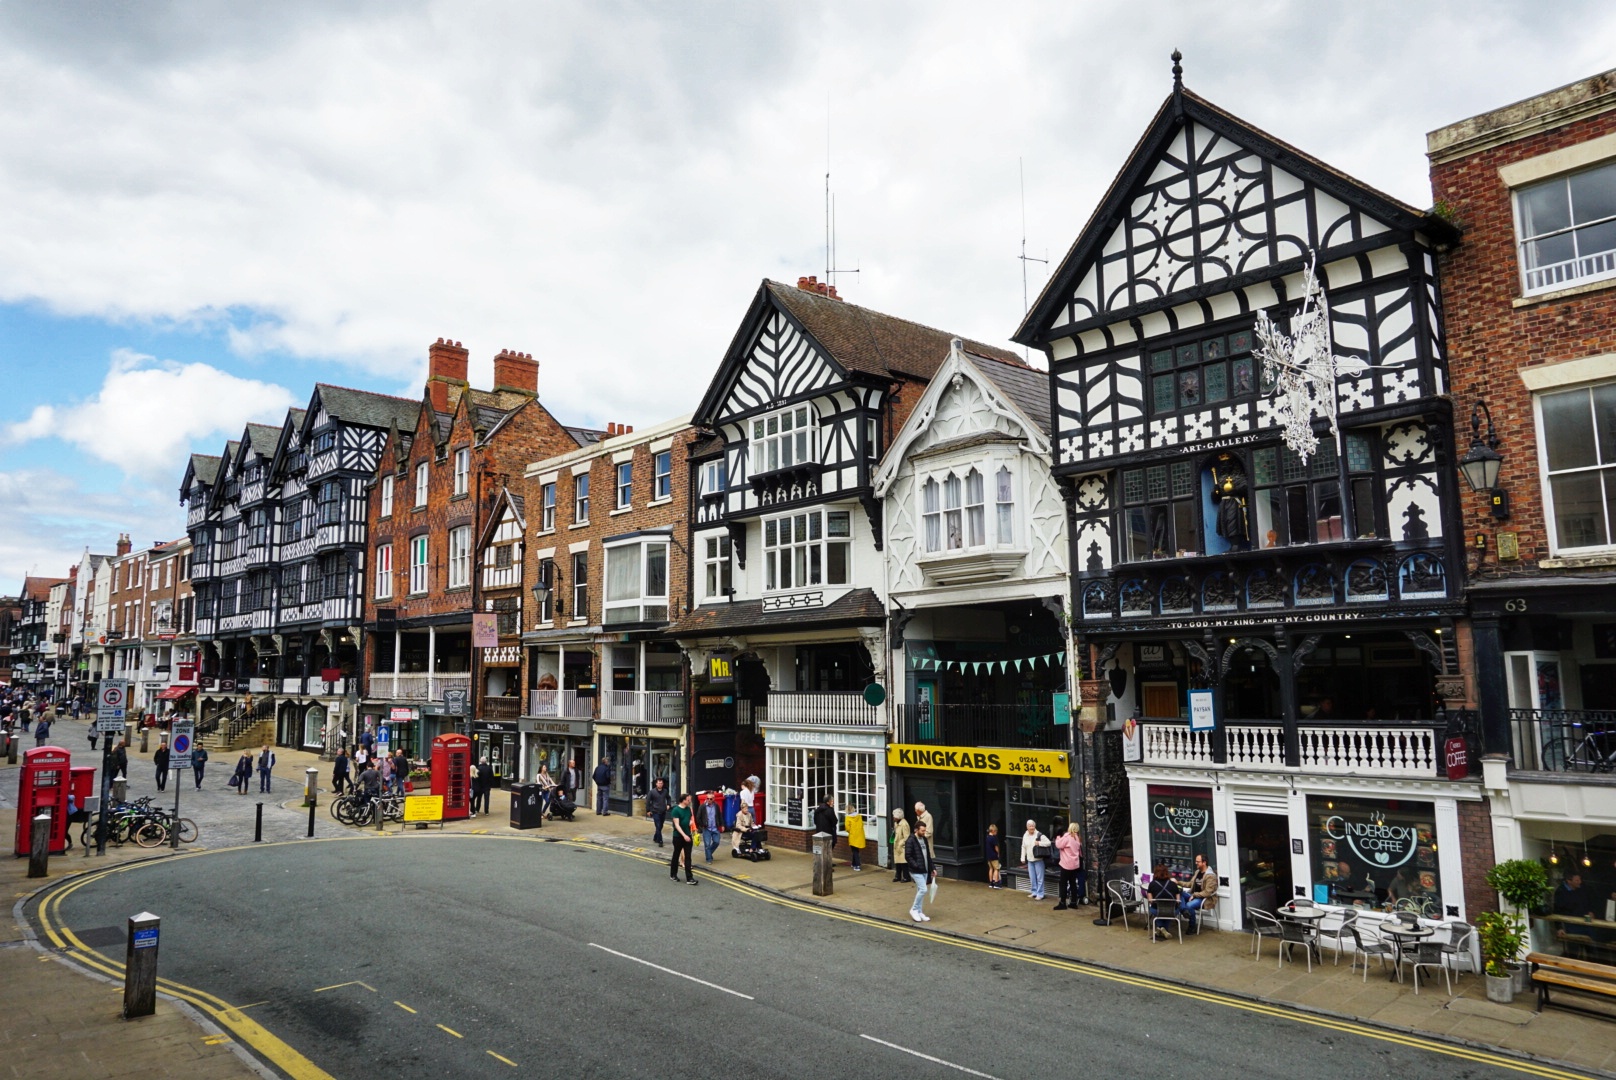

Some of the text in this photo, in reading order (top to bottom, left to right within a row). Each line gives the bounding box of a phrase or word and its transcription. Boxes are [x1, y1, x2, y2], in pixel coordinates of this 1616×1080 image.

[1182, 434, 1257, 454] ART GALLERY
[1505, 598, 1527, 612] 63
[1234, 618, 1255, 626] KING
[1305, 613, 1360, 621] COUNTRY
[711, 657, 732, 677] MR.
[534, 722, 570, 732] LILY VINTAGE
[620, 726, 649, 736] CITY GATE
[788, 731, 847, 744] COFFEE MILL
[899, 749, 1002, 771] KINGKABS
[1446, 750, 1467, 768] COFFEE
[1008, 762, 1052, 774] 34 34 34
[1153, 802, 1206, 819] CINDERBOX
[1173, 817, 1200, 827] COFFEE
[1326, 815, 1412, 840] CINDERBOX
[1360, 837, 1404, 853] COFFEE
